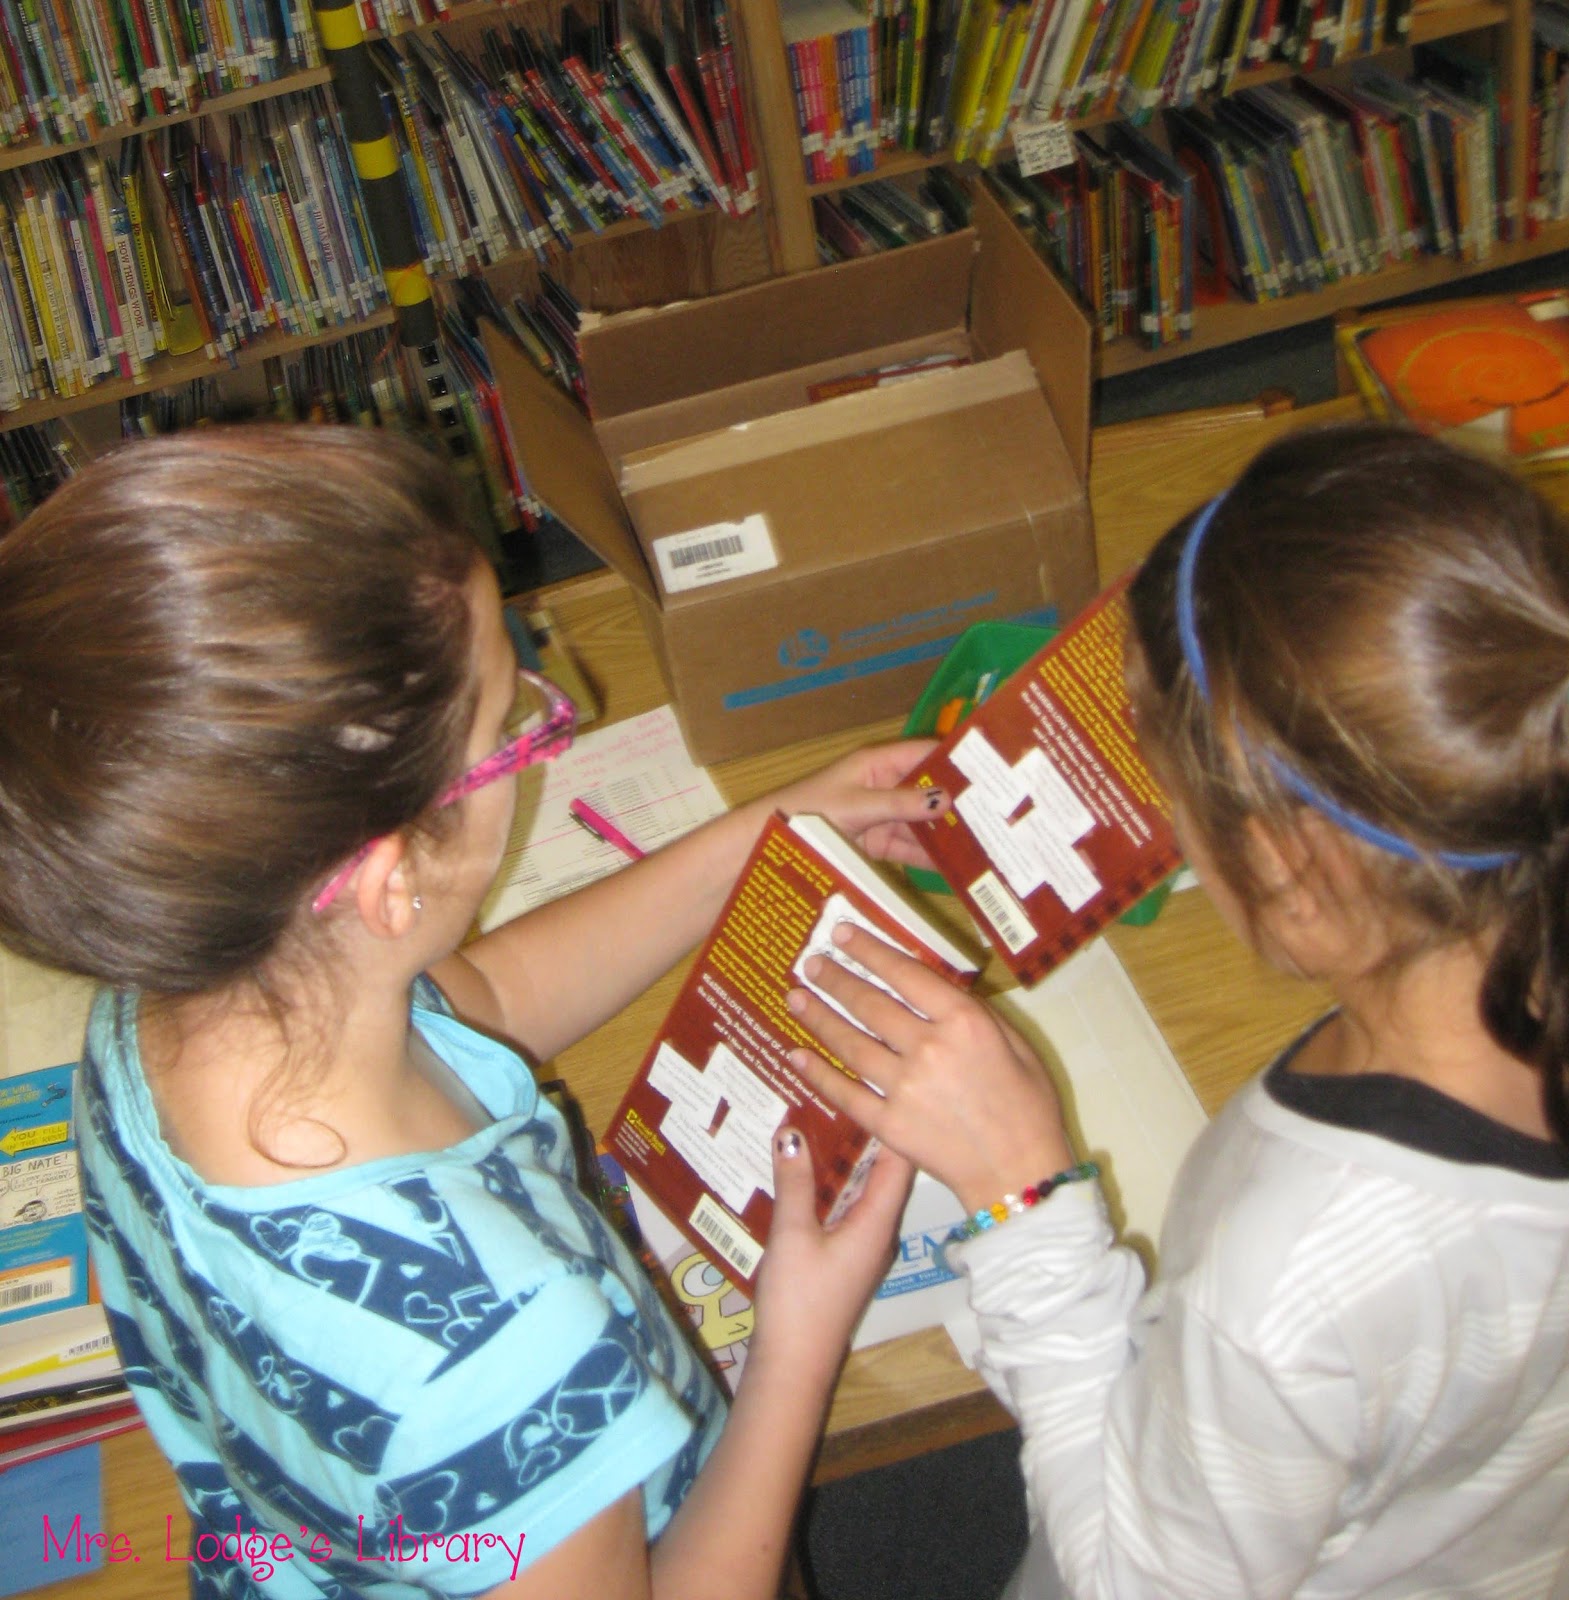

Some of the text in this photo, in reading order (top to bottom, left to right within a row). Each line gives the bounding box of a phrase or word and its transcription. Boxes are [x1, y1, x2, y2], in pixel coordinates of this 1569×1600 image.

[312, 210, 329, 241] HUMAN
[116, 240, 145, 328] HOW THINGS WORK
[1027, 680, 1056, 714] READERS
[1050, 709, 1069, 731] LOVE
[1074, 741, 1095, 764] DIARY
[1102, 777, 1125, 803] WIMPY
[699, 972, 733, 1004] READERS
[727, 998, 744, 1015] LOVE
[740, 1010, 756, 1026] THE
[750, 1021, 774, 1043] DIARY
[714, 1003, 736, 1025] Today,
[730, 1019, 764, 1051] Publishers
[757, 1045, 785, 1072] Weekly,
[779, 1065, 798, 1084] Wall
[791, 1077, 815, 1100] Street
[752, 1058, 773, 1079] Times
[10, 1125, 62, 1141] YOU FILL
[1, 1154, 69, 1177] BIG NATE!
